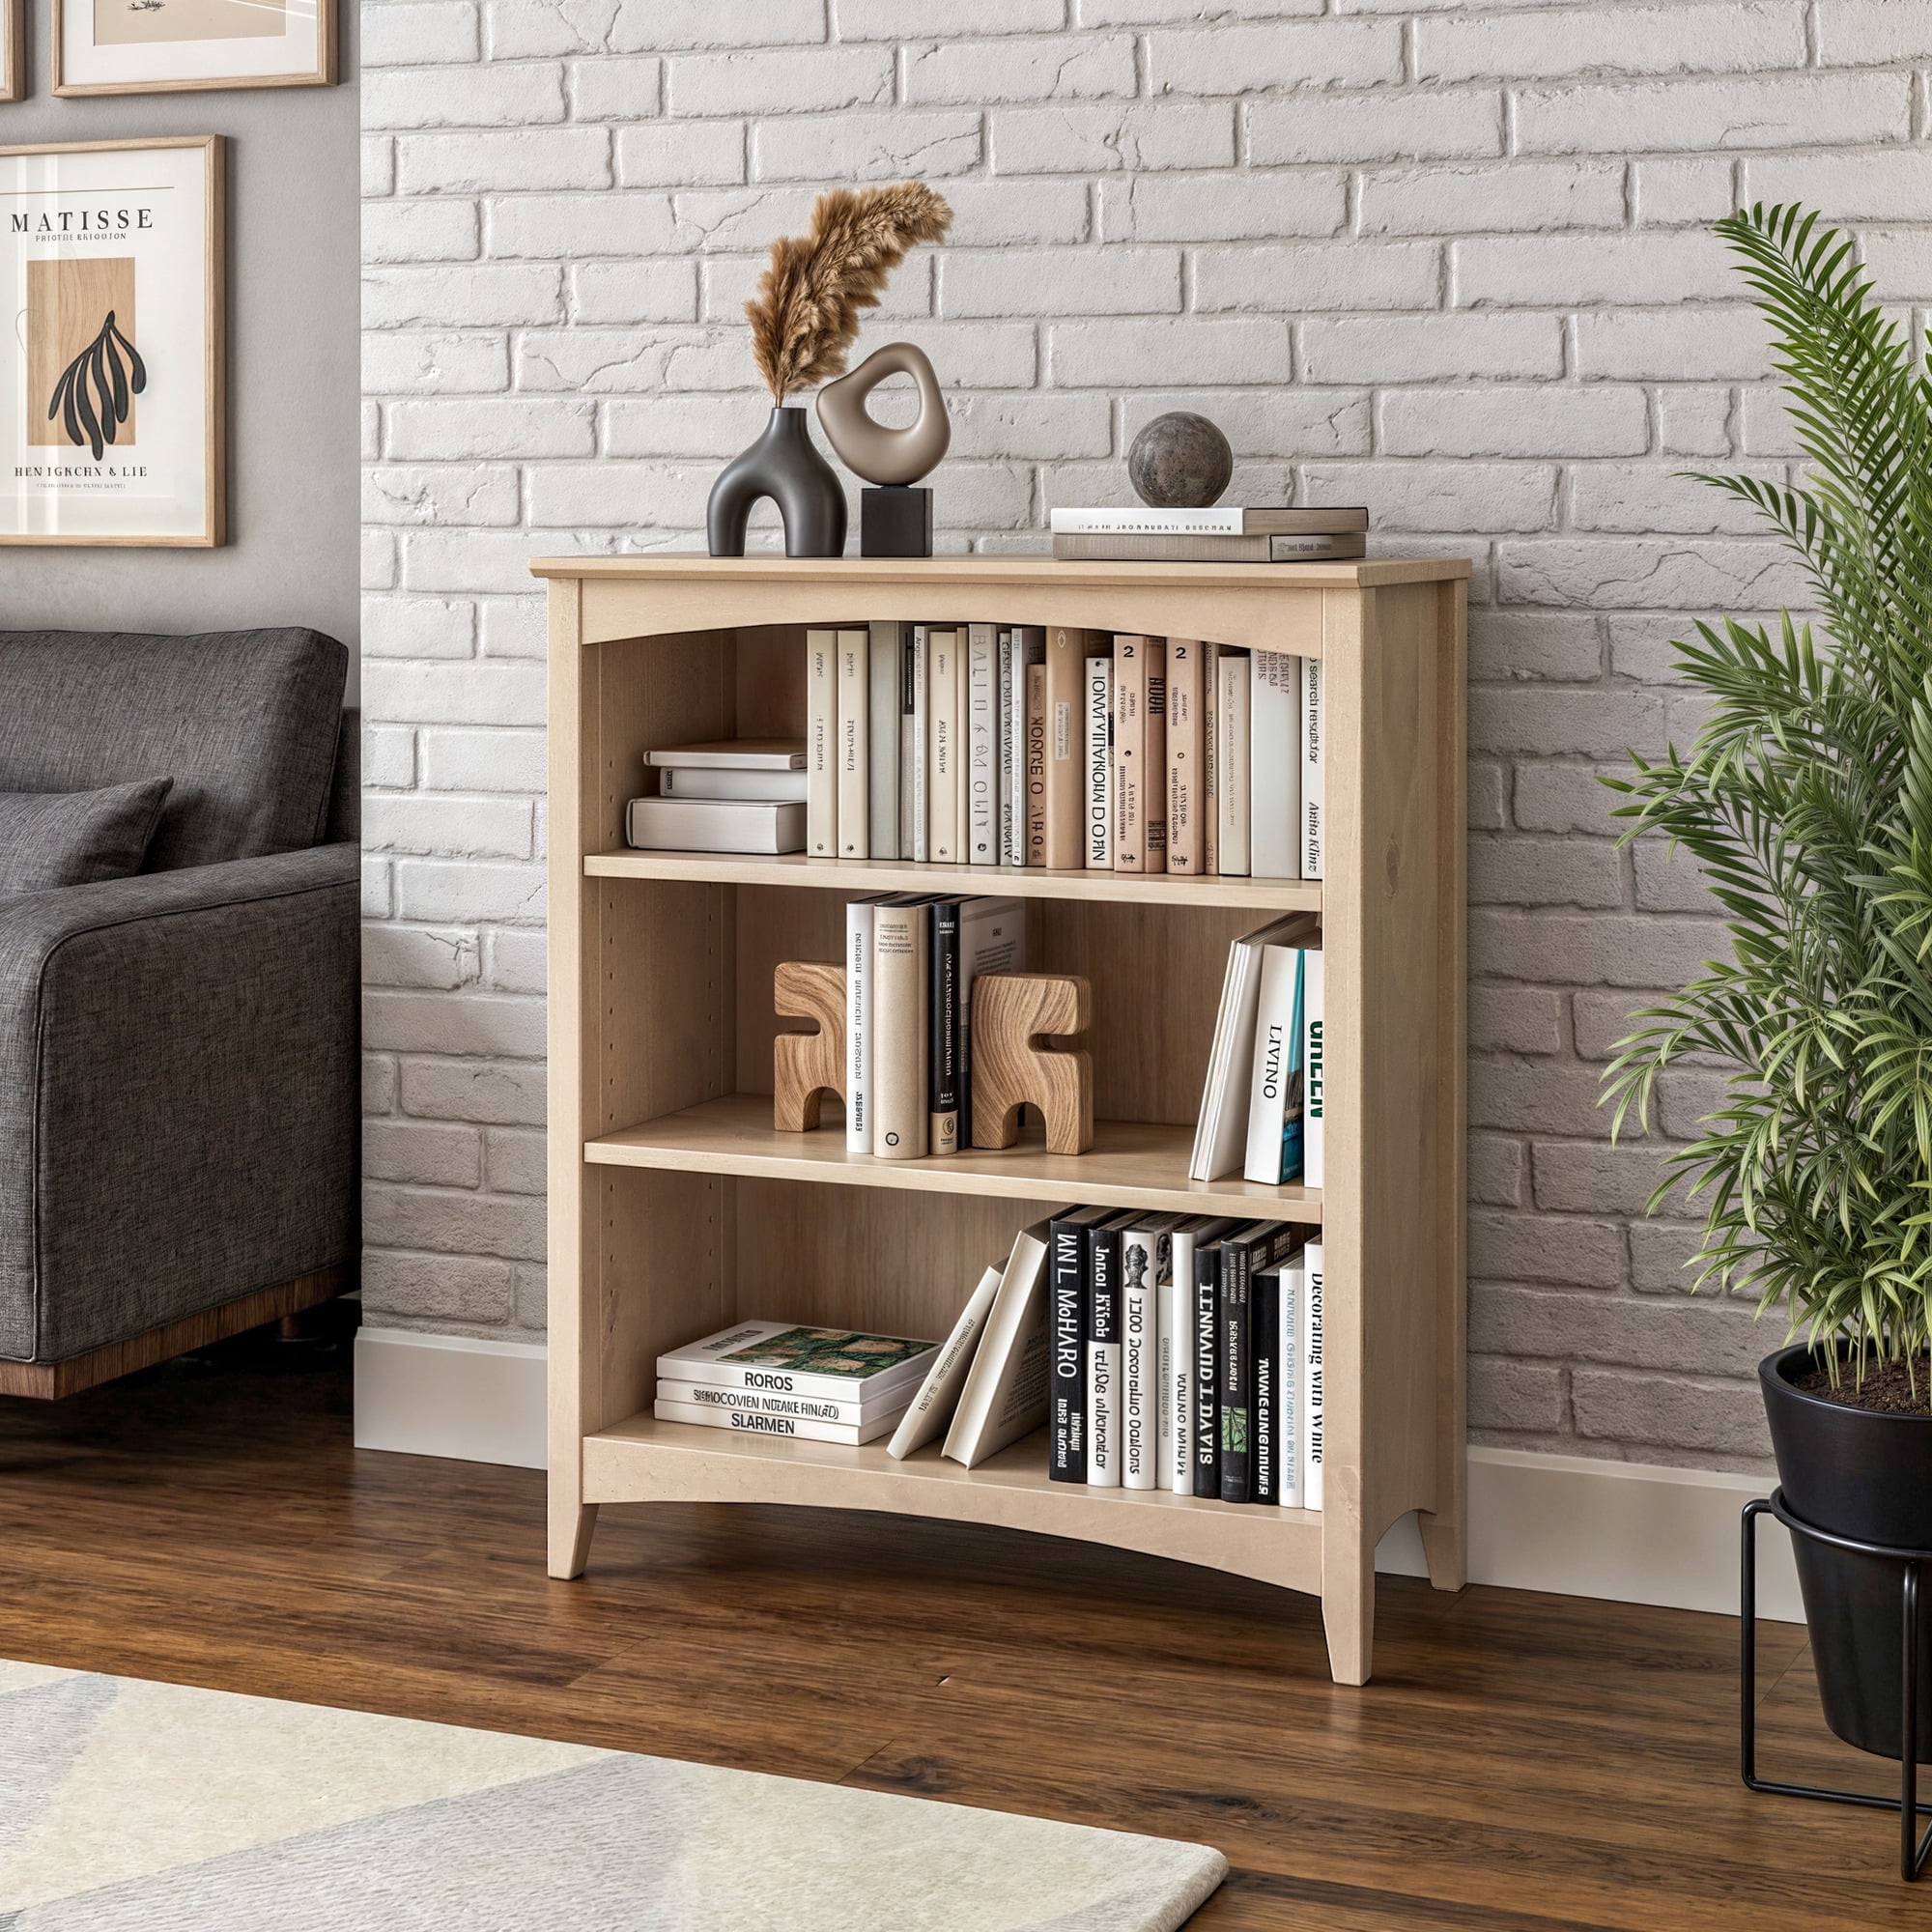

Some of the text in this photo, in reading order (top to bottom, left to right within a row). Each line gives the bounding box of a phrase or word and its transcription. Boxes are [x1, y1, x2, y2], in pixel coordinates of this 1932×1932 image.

[11, 209, 154, 233] MATISSE
[1124, 645, 1134, 658] 2
[1176, 646, 1186, 659] 2
[1309, 665, 1321, 706] search
[1308, 1272, 1323, 1463] Decorating with White
[745, 1372, 793, 1391] ROROS
[731, 1412, 795, 1435] SLARMEN
